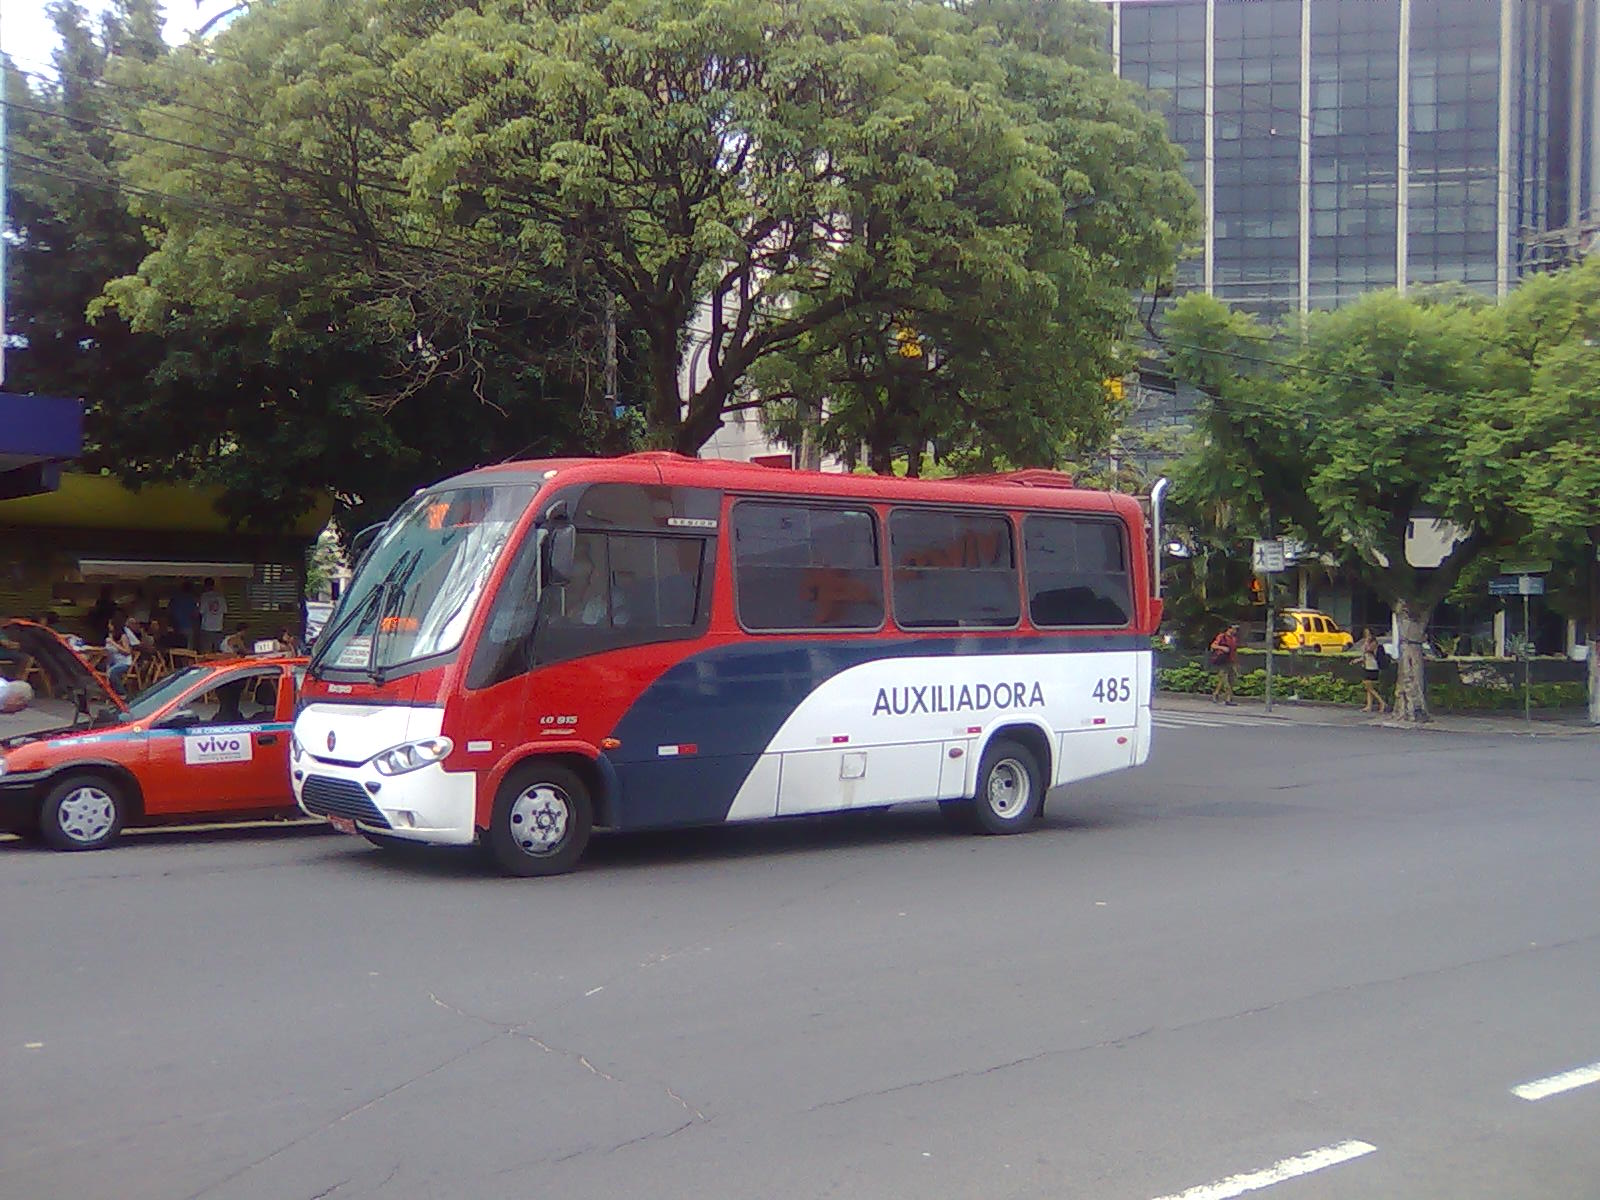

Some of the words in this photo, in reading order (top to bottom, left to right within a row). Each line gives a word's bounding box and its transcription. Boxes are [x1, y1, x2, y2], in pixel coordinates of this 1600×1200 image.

[872, 681, 1046, 716] AUXILIADORA
[1092, 677, 1131, 703] 485
[197, 736, 240, 752] vivo
